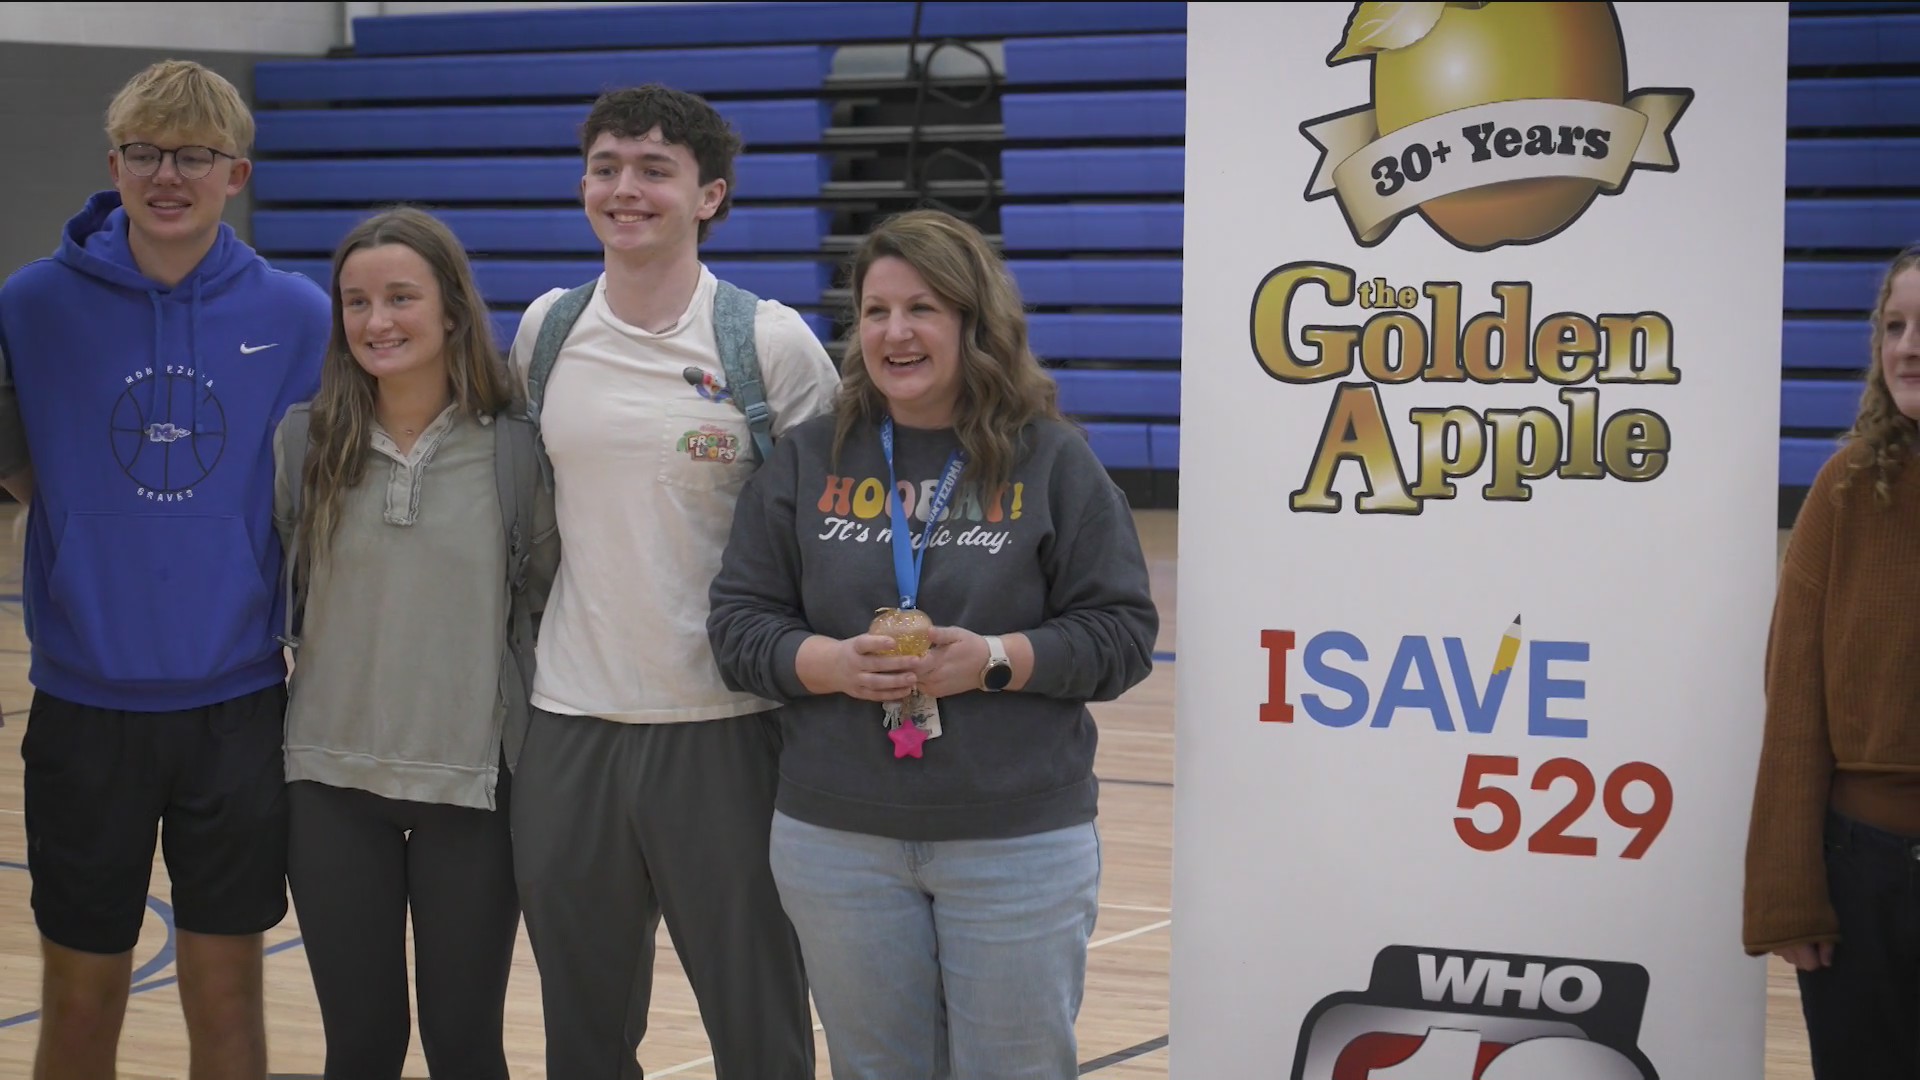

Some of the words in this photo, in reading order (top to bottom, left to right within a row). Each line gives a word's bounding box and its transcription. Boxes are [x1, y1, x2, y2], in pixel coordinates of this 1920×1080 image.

[1371, 141, 1452, 197] 30+
[1462, 121, 1611, 163] Years
[1250, 260, 1682, 385] Golden
[1358, 278, 1419, 309] the
[1289, 382, 1671, 515] Apple
[137, 487, 193, 502] BRAVES
[818, 517, 870, 542] It's
[956, 525, 1012, 554] day.
[1454, 754, 1674, 860] 529
[1417, 953, 1602, 1014] WHO
